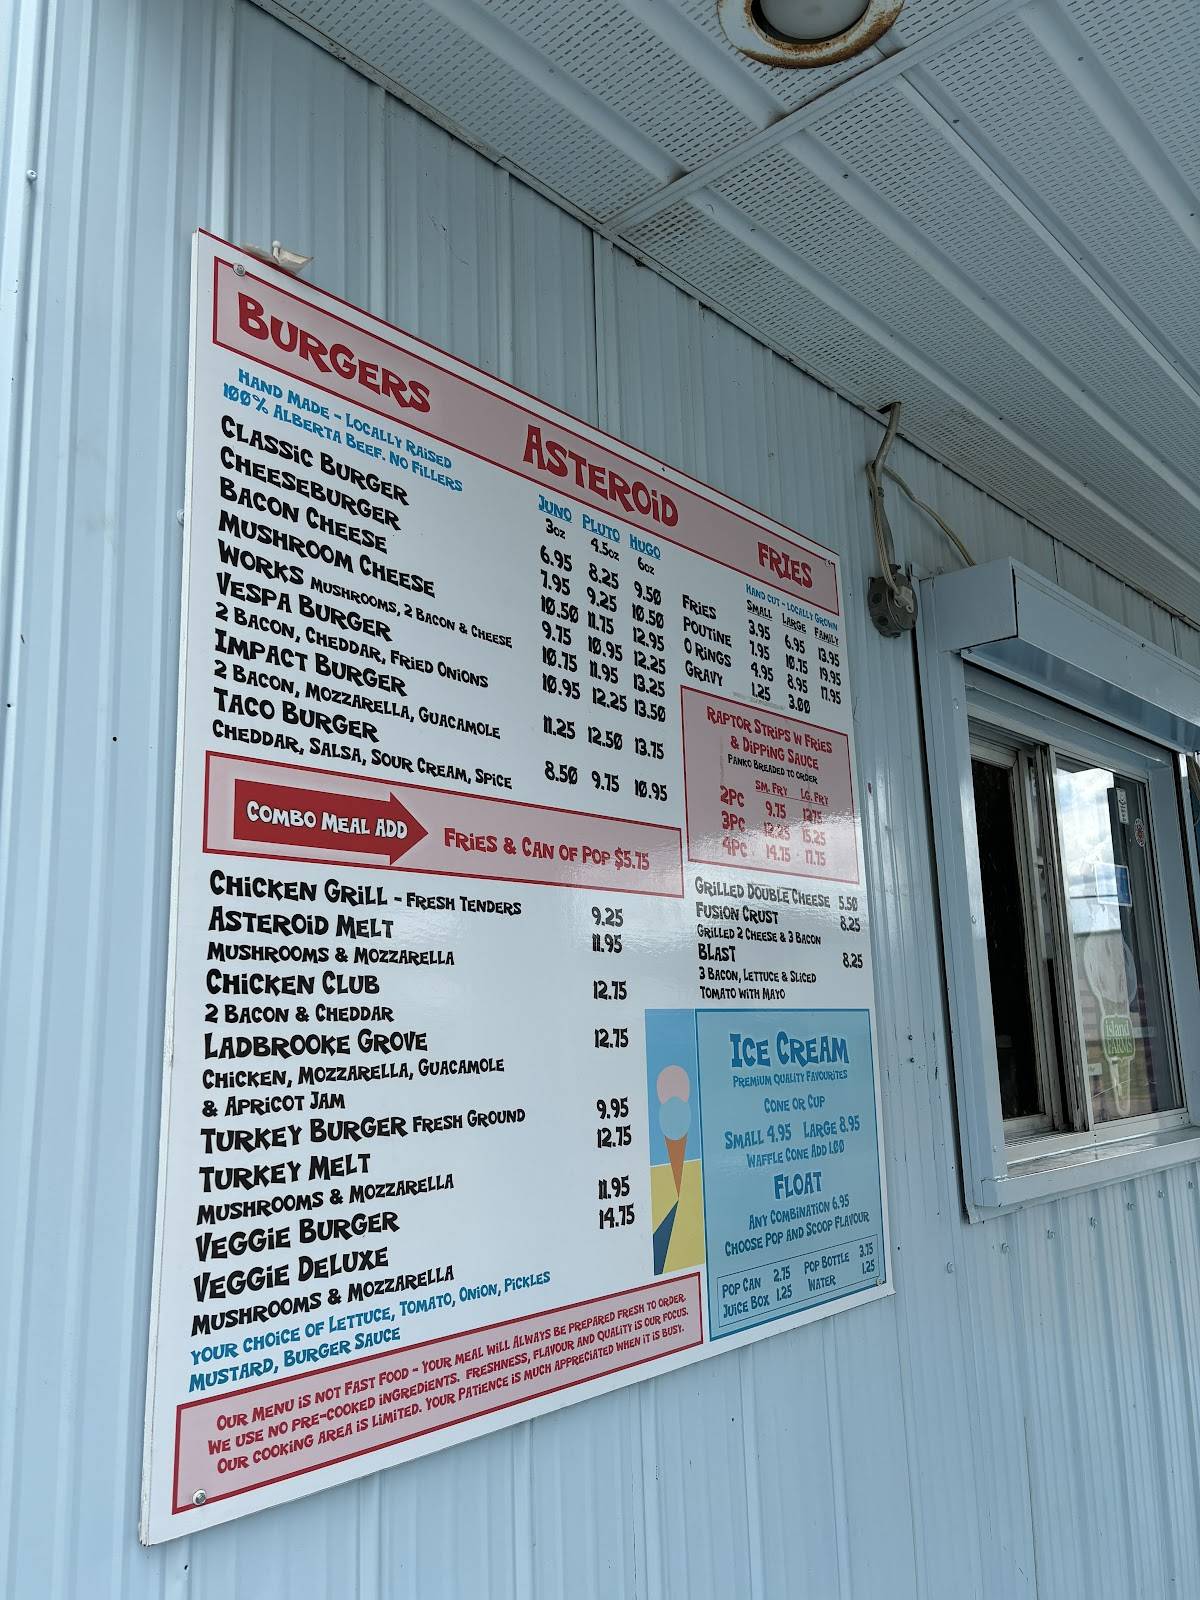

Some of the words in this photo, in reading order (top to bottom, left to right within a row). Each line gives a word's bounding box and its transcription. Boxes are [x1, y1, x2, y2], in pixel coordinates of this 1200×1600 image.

[238, 291, 430, 412] BURGERS
[238, 368, 282, 398] HAND
[287, 389, 329, 419] MADE
[345, 412, 401, 448] LOCALLY
[273, 404, 341, 443] ALBERTA
[345, 432, 385, 460] BEEF.
[389, 450, 408, 469] NO
[220, 445, 400, 530] CHEESEBURGER
[320, 451, 409, 505] BURGER
[219, 476, 299, 522] BACON
[305, 506, 387, 554] CHEESE
[538, 493, 571, 520] JUNO
[582, 513, 620, 541] PLUTO
[629, 533, 660, 558] HUGO
[218, 509, 353, 573] MUSHROOM
[359, 554, 435, 598] CHEESE
[540, 544, 572, 572] 6.95
[588, 562, 619, 589] 8.25
[757, 541, 812, 588] FRIES
[216, 571, 292, 613] VESPA
[298, 593, 392, 642] BURGER
[217, 538, 303, 584] WORKS
[310, 576, 400, 616] MUSHROOMS,
[403, 603, 412, 618] 2
[415, 607, 455, 630] BACON
[458, 622, 467, 634] &
[471, 624, 512, 648] CHEESE
[540, 568, 570, 595] 7.95
[586, 586, 617, 612] 9.25
[587, 610, 614, 634] 11.75
[632, 626, 664, 651] 12.95
[746, 599, 772, 619] SMALL
[781, 612, 806, 634] LARGE
[541, 620, 571, 645] 9.75
[633, 650, 665, 674] 12.25
[748, 619, 770, 640] 3.95
[784, 633, 805, 654] 6.95
[817, 647, 839, 667] 13.95
[214, 627, 308, 671] IMPACT
[315, 652, 407, 696] BURGER
[684, 659, 722, 686] GRAVY
[749, 639, 769, 660] 7.95
[819, 666, 841, 686] 19.95
[750, 661, 773, 681] 4.95
[786, 673, 808, 693] 8.95
[820, 685, 841, 704] 17.95
[751, 681, 770, 701] 1.25
[213, 686, 274, 719] TACO
[282, 700, 379, 743] BURGER
[706, 705, 752, 733] RAPTOR
[212, 719, 304, 755] CHEDDAR,
[309, 737, 366, 766] SALSA,
[370, 748, 414, 773] SOUR
[417, 757, 471, 784] CREAM,
[730, 735, 739, 749] &
[787, 748, 819, 770] SAUCE
[591, 770, 619, 792] 9.75
[719, 785, 744, 807] 2PC
[246, 800, 316, 827] COMBO
[321, 812, 369, 834] MEAL
[374, 818, 406, 838] ADD
[765, 800, 786, 819] 9.75
[502, 836, 516, 855] &
[521, 836, 554, 859] CAN
[558, 844, 577, 861] OF
[582, 845, 610, 865] POP
[614, 845, 649, 870] $5.75
[746, 882, 790, 905] DOUBLE
[790, 887, 830, 909] CHEESE
[335, 914, 393, 939] MELT
[591, 906, 623, 927] 9.25
[742, 904, 778, 924] CRUST
[839, 915, 860, 932] 8.25
[591, 932, 622, 953] 11.95
[697, 942, 735, 962] BLAST
[842, 952, 863, 968] 8.25
[322, 970, 379, 994] CLUB
[593, 980, 627, 1000] 12.75
[204, 1032, 350, 1059] LADBROOKE
[357, 1028, 427, 1054] GROVE
[594, 1027, 628, 1048] 12.75
[1105, 1019, 1130, 1037] island
[1106, 1037, 1133, 1054] FARMS
[729, 1033, 770, 1067] ICE
[776, 1031, 849, 1067] CREAM
[596, 1096, 628, 1119] 9.95
[200, 1124, 302, 1153] TURKEY
[309, 1116, 408, 1142] BURGER
[724, 1129, 764, 1149] SMALL
[766, 1122, 791, 1142] 4.95
[802, 1120, 837, 1138] LARGE
[839, 1114, 860, 1132] 8.95
[773, 1171, 821, 1199] FLOAT
[598, 1202, 634, 1229] 14.75
[297, 1246, 388, 1281] DELUXE
[721, 1282, 740, 1298] POP
[742, 1277, 760, 1292] CAN
[773, 1265, 790, 1282] 2.75
[189, 1358, 278, 1392] MUSTARD,
[284, 1340, 351, 1367] BURGER
[355, 1327, 400, 1349] SAUCE
[216, 1413, 248, 1430] OUR
[251, 1398, 294, 1422] MENU
[315, 1385, 341, 1403] NOT
[344, 1376, 375, 1395] FAST
[379, 1367, 408, 1385] FOOD
[421, 1356, 452, 1373] YOUR
[454, 1346, 483, 1365] MEAL
[512, 1328, 551, 1348] ALWAYS
[553, 1325, 566, 1336] BE
[568, 1311, 615, 1333] PREPARED
[617, 1303, 644, 1319] FRESH
[646, 1299, 656, 1311] TO
[658, 1293, 686, 1307] ORDER.
